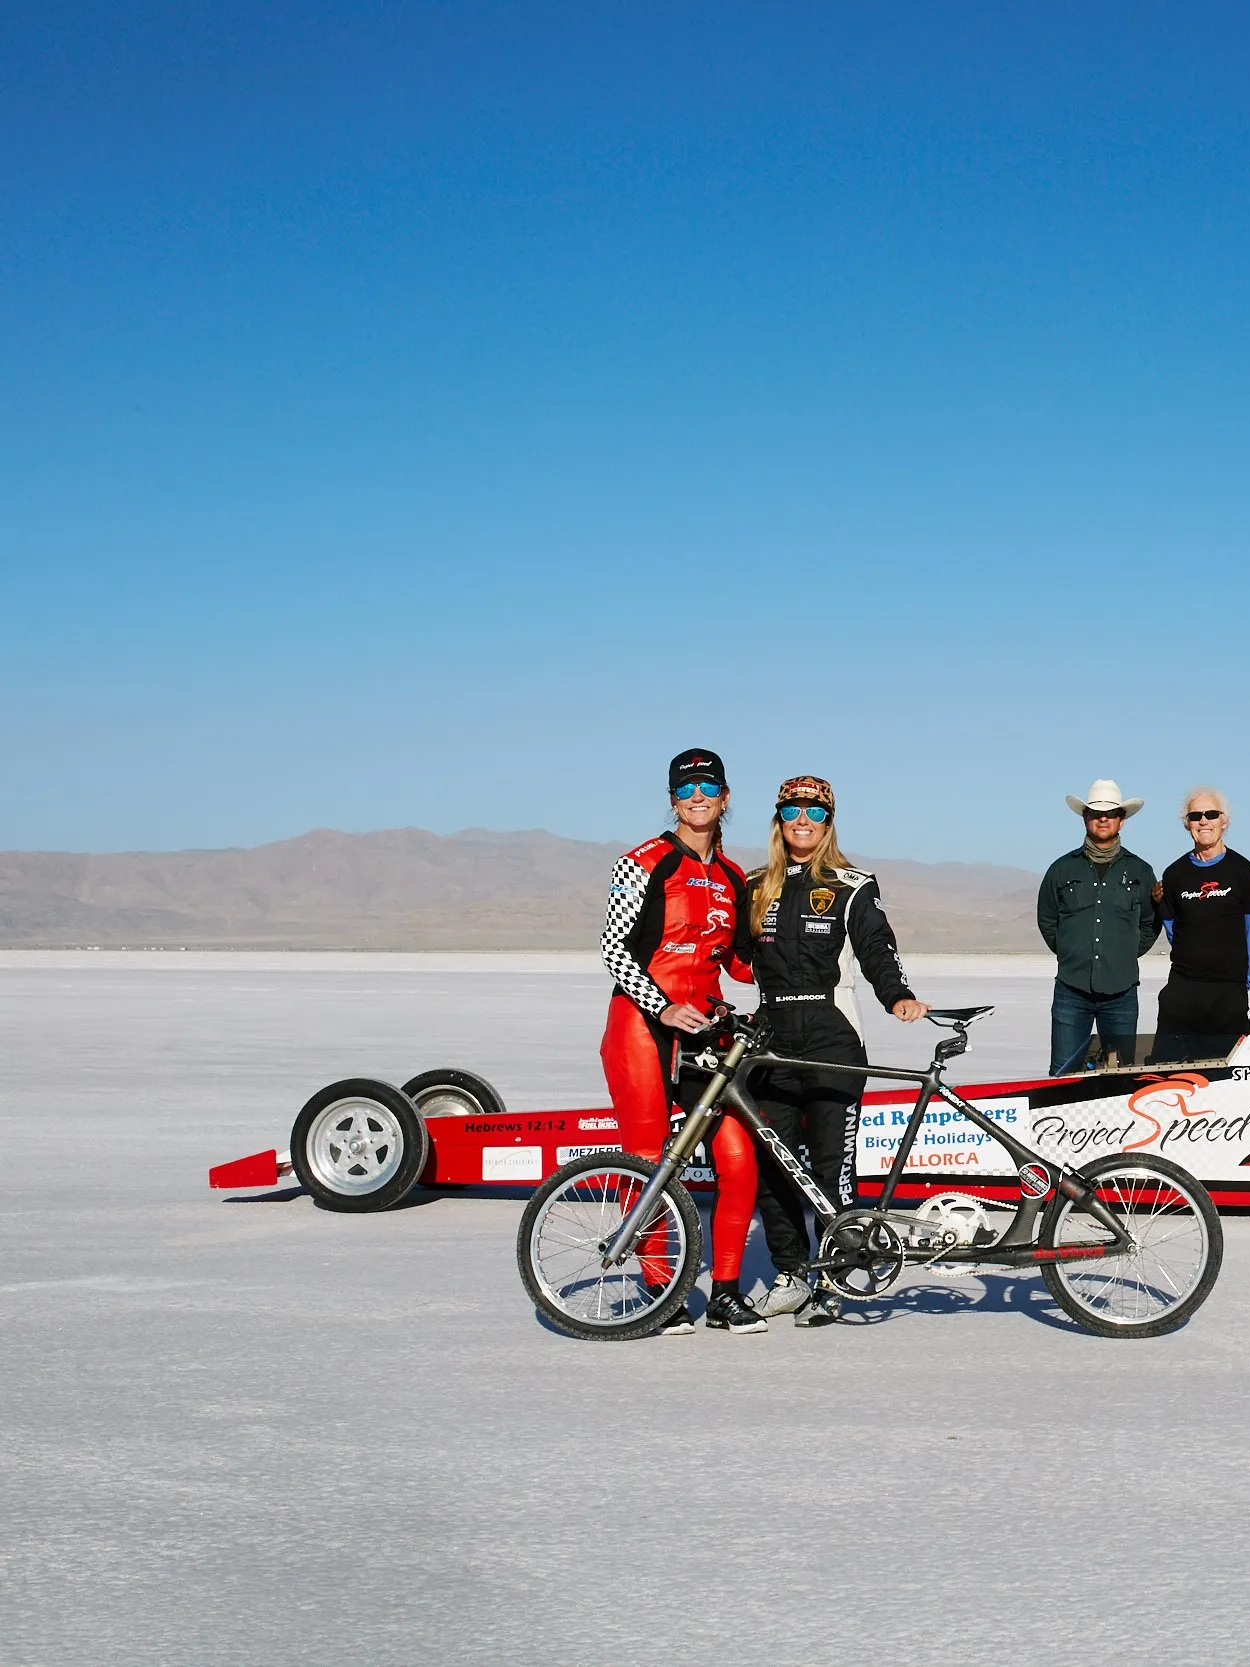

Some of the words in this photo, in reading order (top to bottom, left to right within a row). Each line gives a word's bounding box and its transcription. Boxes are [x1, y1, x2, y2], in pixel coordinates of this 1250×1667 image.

[465, 1120, 522, 1133] Hebrews
[527, 1120, 566, 1132] 12:1-2
[859, 1111, 885, 1127] ed
[892, 1107, 1017, 1127] Rompeerg
[924, 1132, 992, 1146] Holidays
[1032, 1116, 1135, 1153] Project
[838, 1102, 859, 1206] PERTAMINA
